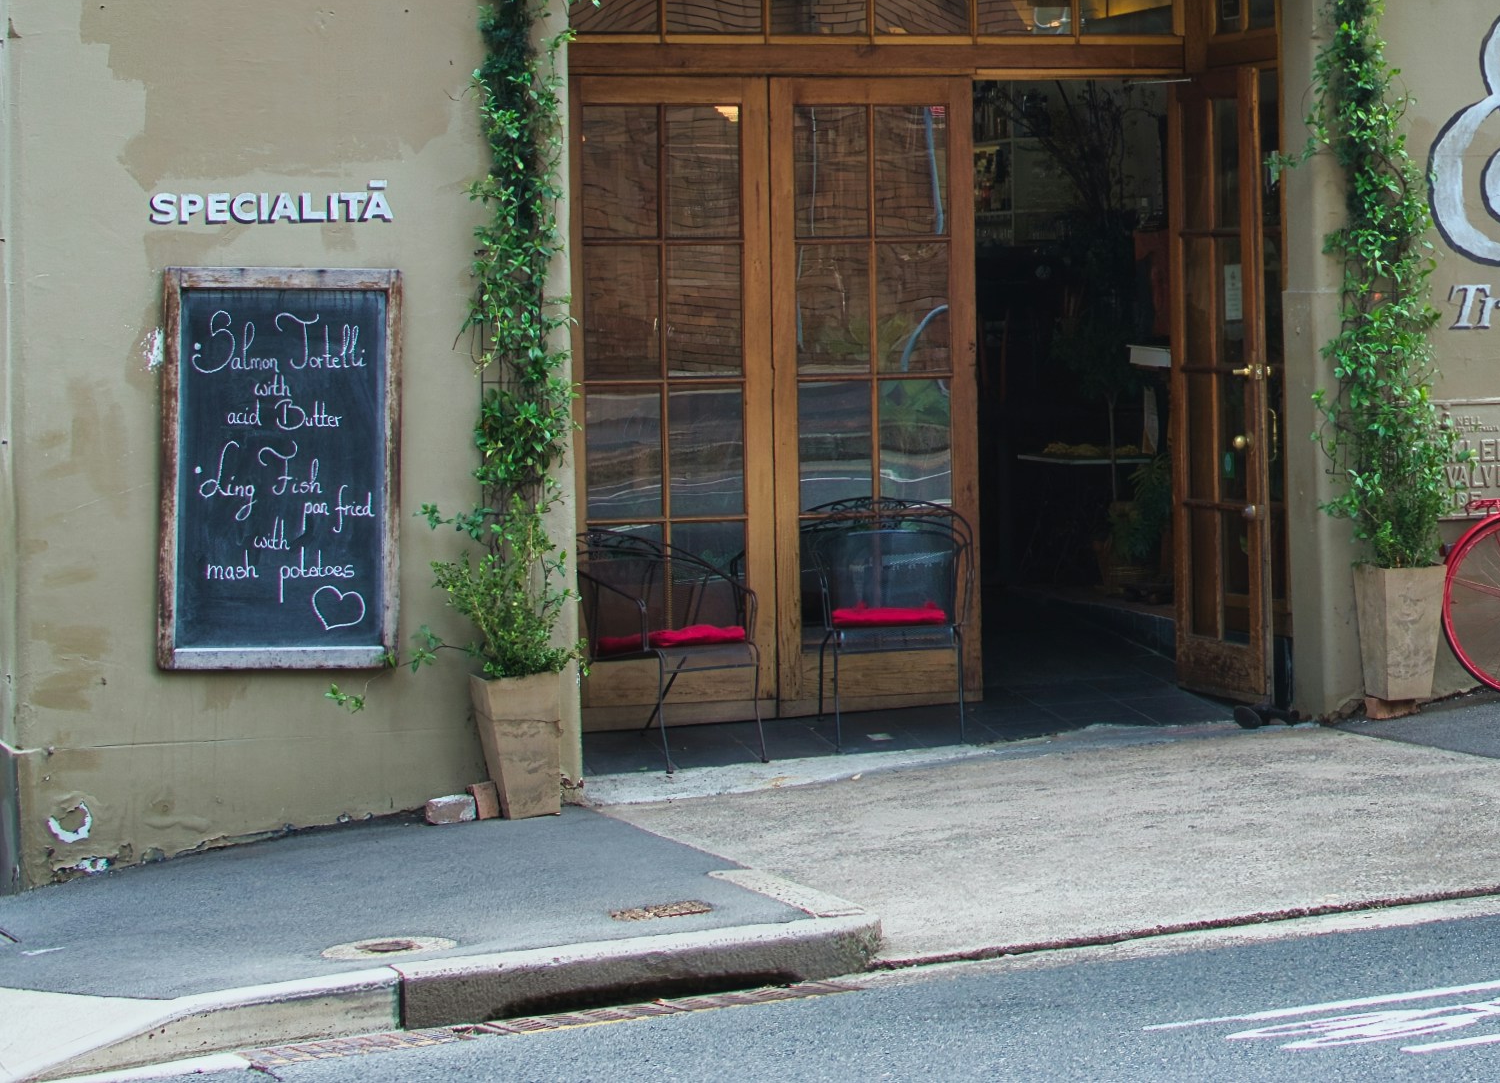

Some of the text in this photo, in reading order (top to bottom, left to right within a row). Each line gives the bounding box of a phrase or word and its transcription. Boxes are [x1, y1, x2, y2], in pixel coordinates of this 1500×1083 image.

[192, 310, 367, 374] Salmon Tortelli
[255, 374, 291, 396] with
[227, 399, 343, 430] acid Butter
[199, 440, 322, 521] Ling Fish
[302, 484, 375, 533] pan fried
[253, 516, 290, 550] with
[206, 549, 259, 580] mash
